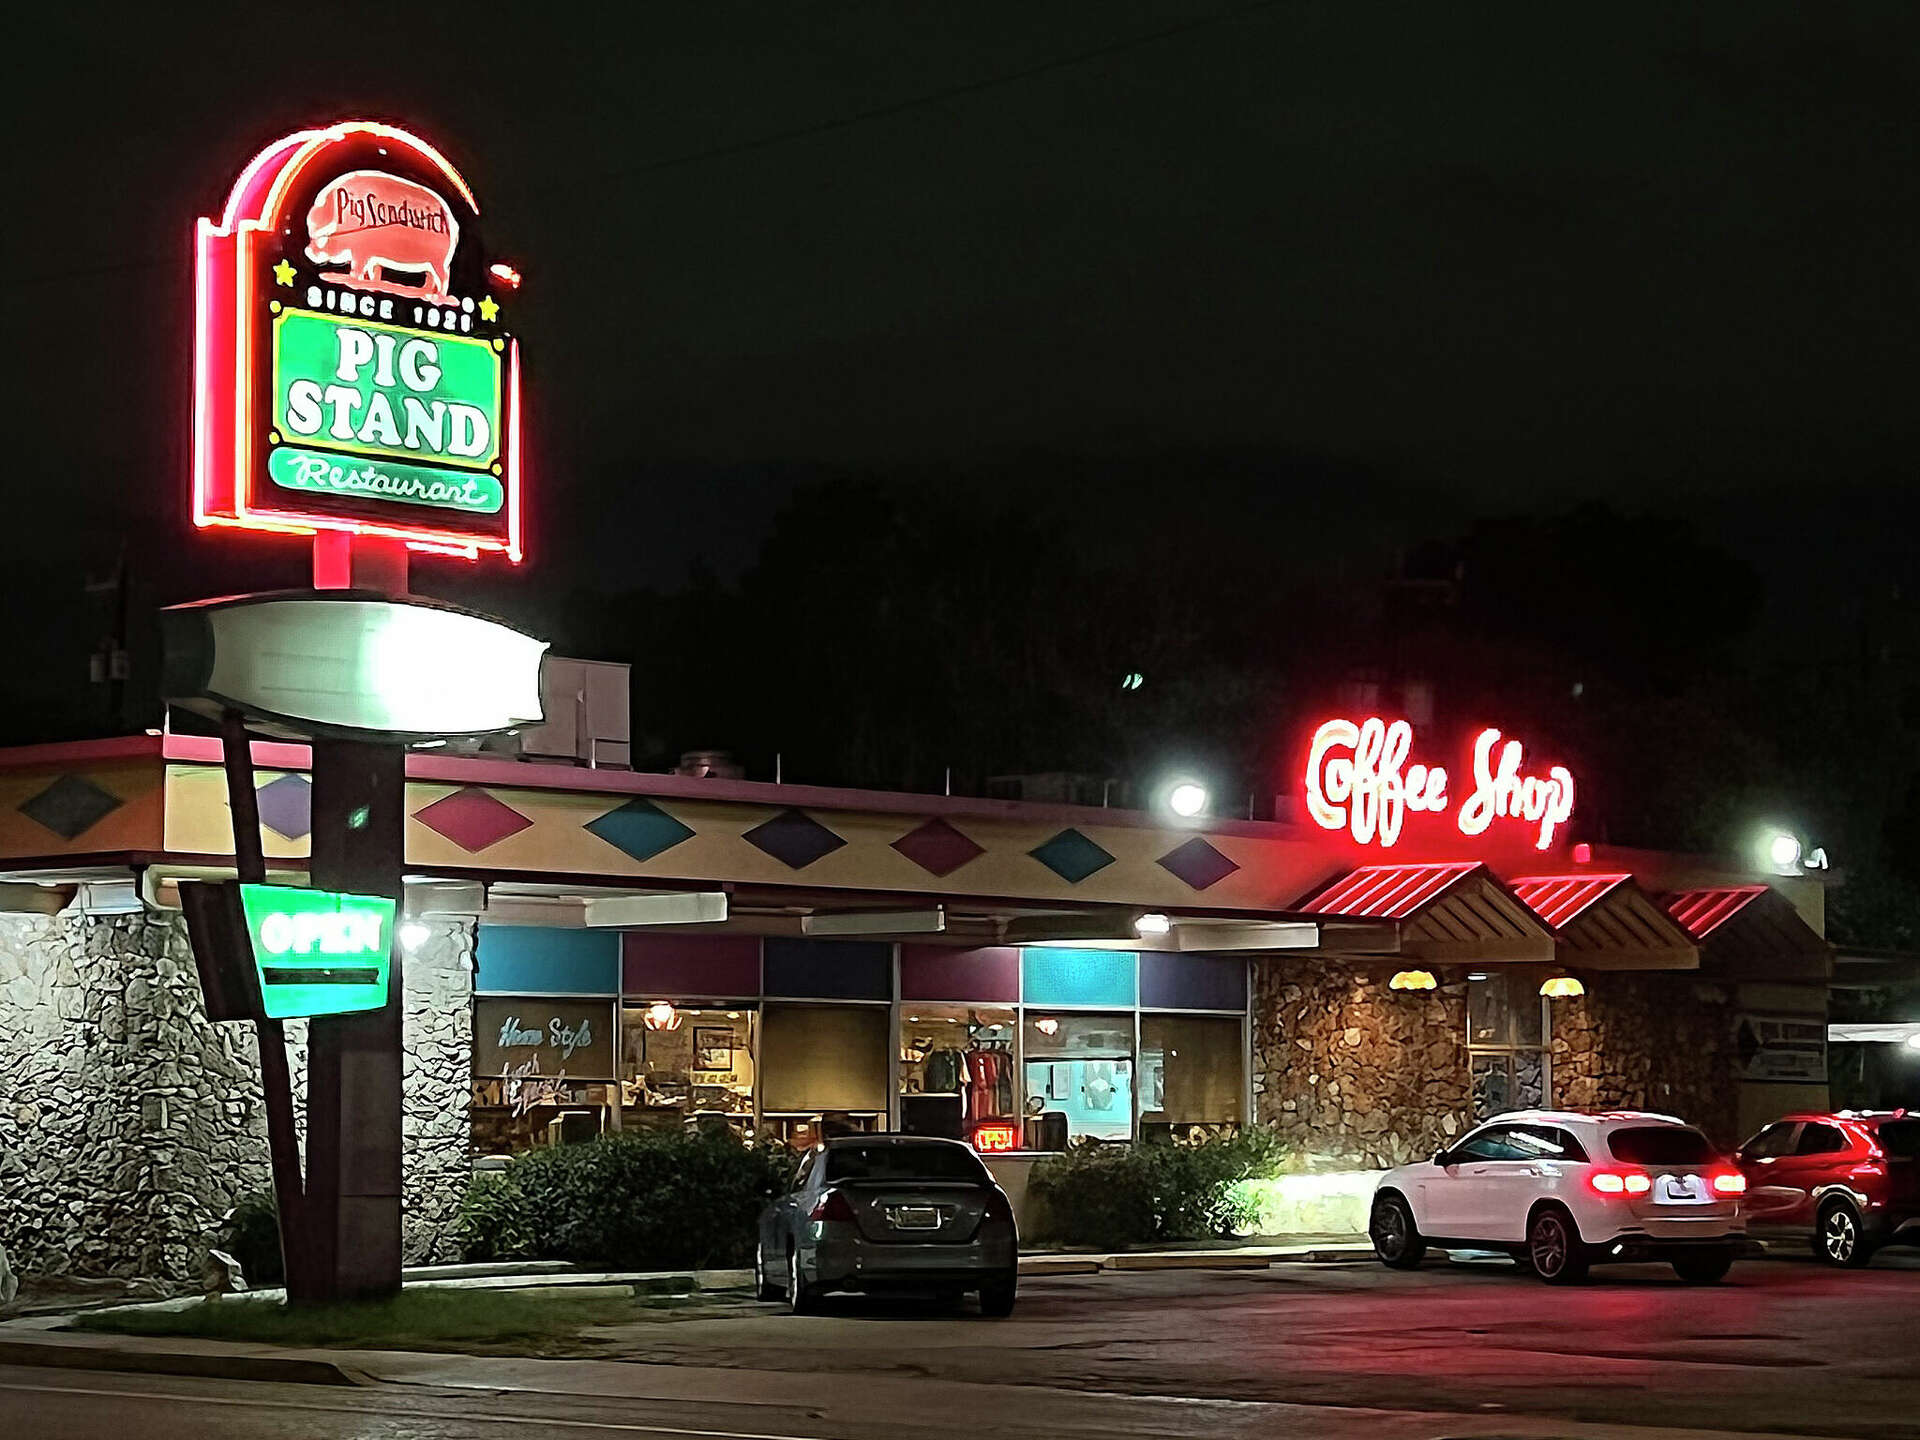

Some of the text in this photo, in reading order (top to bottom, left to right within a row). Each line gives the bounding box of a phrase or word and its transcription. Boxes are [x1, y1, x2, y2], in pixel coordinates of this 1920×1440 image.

[336, 187, 365, 227] Pig
[307, 286, 394, 320] SINCE
[337, 329, 441, 391] PIG
[286, 379, 490, 457] STAND
[287, 456, 489, 503] Restaurant
[1306, 717, 1574, 850] Coffee Shop
